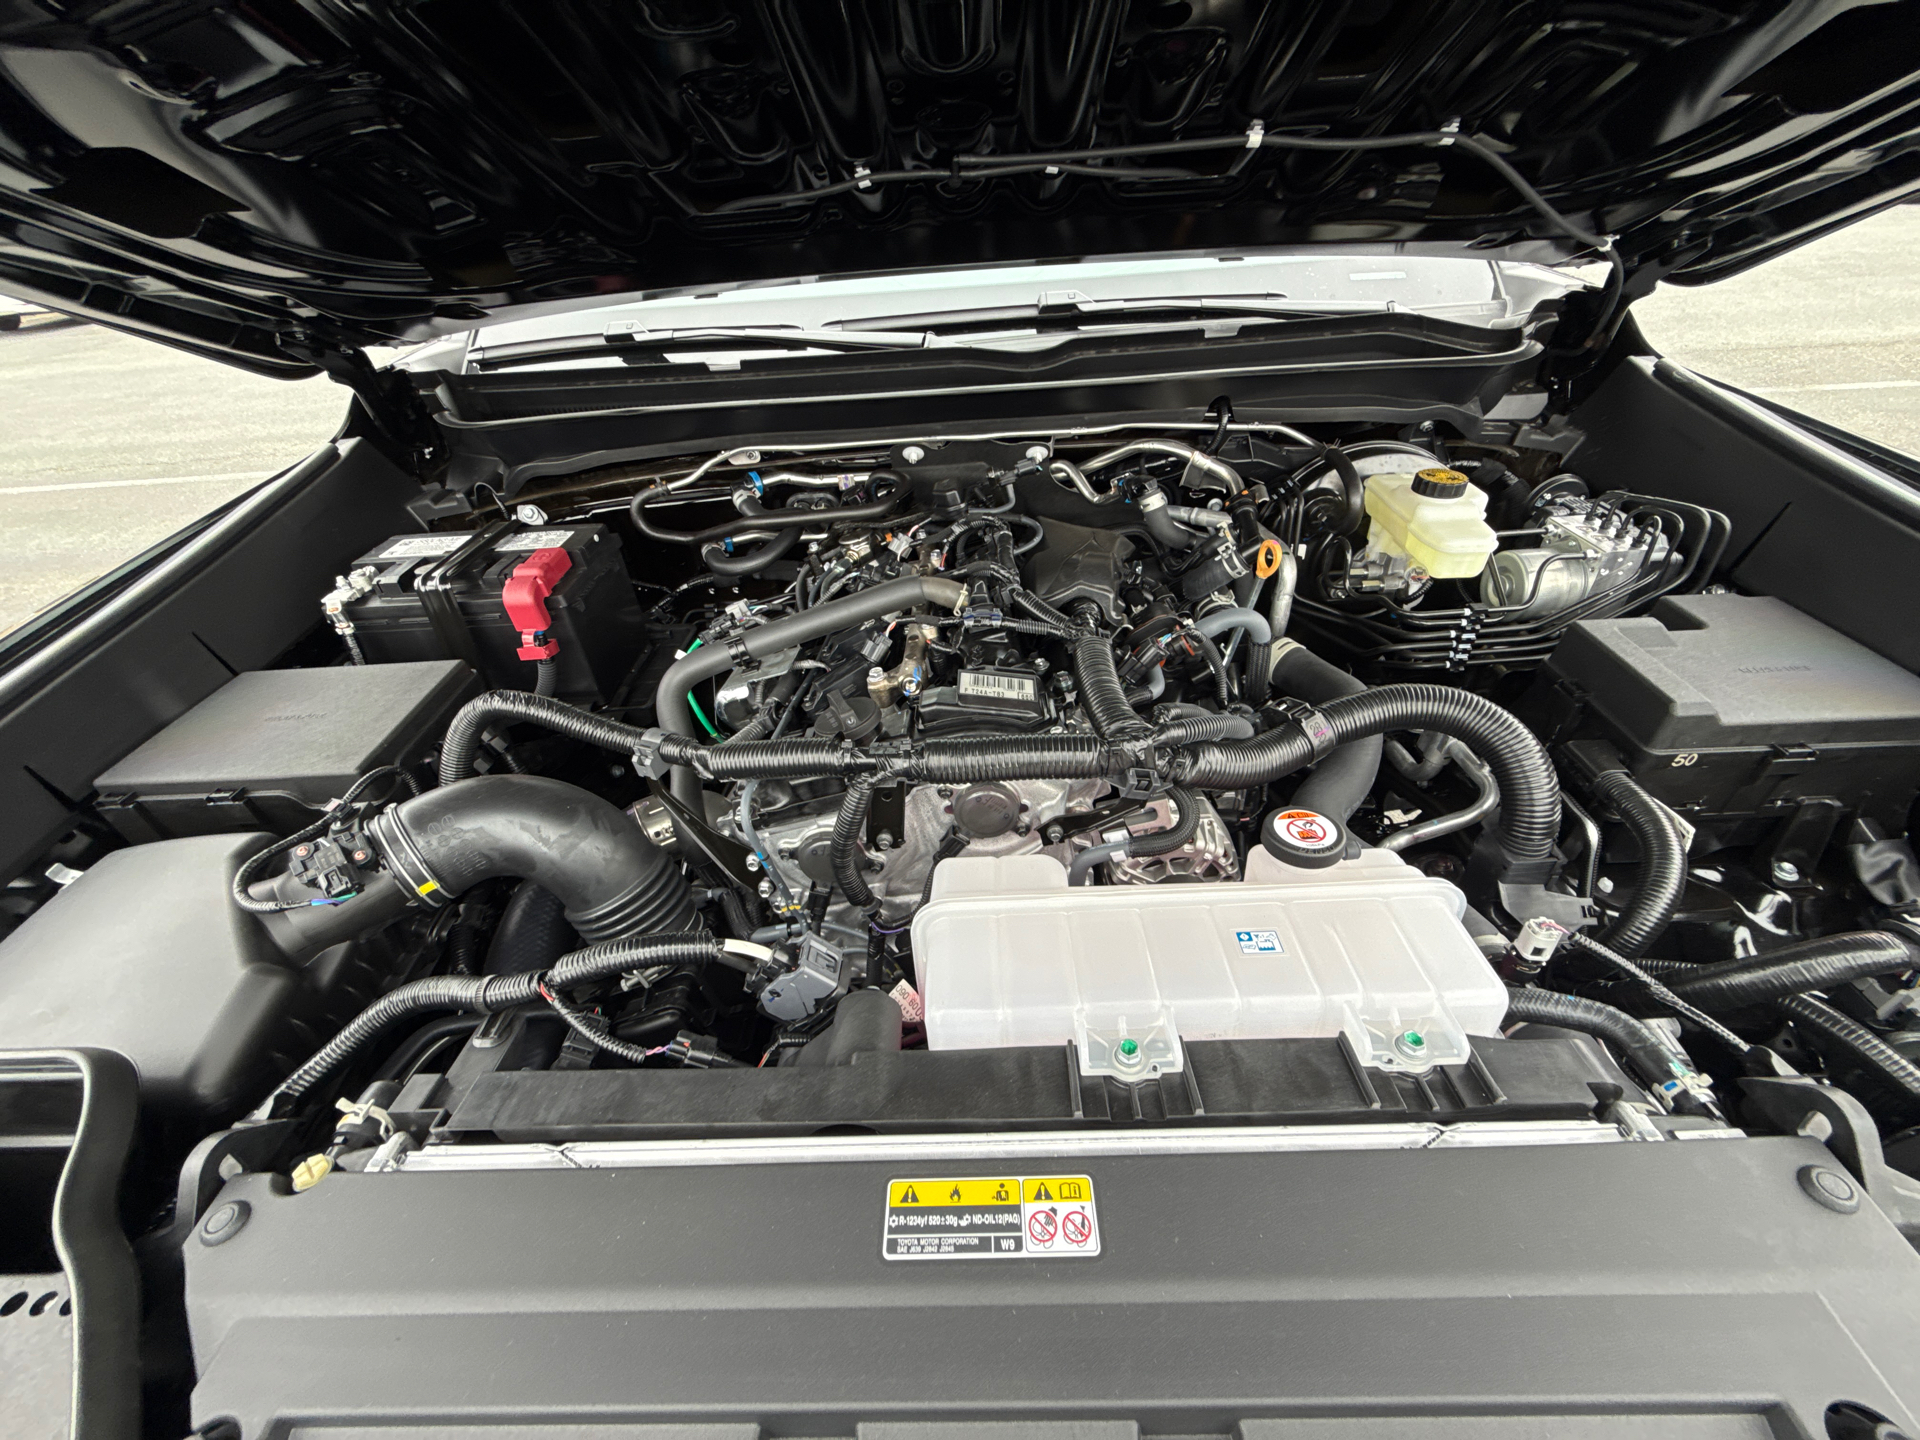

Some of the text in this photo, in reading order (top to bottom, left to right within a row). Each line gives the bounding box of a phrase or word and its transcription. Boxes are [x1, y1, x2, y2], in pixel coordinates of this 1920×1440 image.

[1671, 753, 1698, 767] 50
[899, 1214, 928, 1228] R-1234yf
[972, 1213, 1020, 1226] ND-OIL12(PAG)
[897, 1237, 979, 1246] TOYOTA MOTOR CORPORATION
[1000, 1238, 1015, 1251] W9
